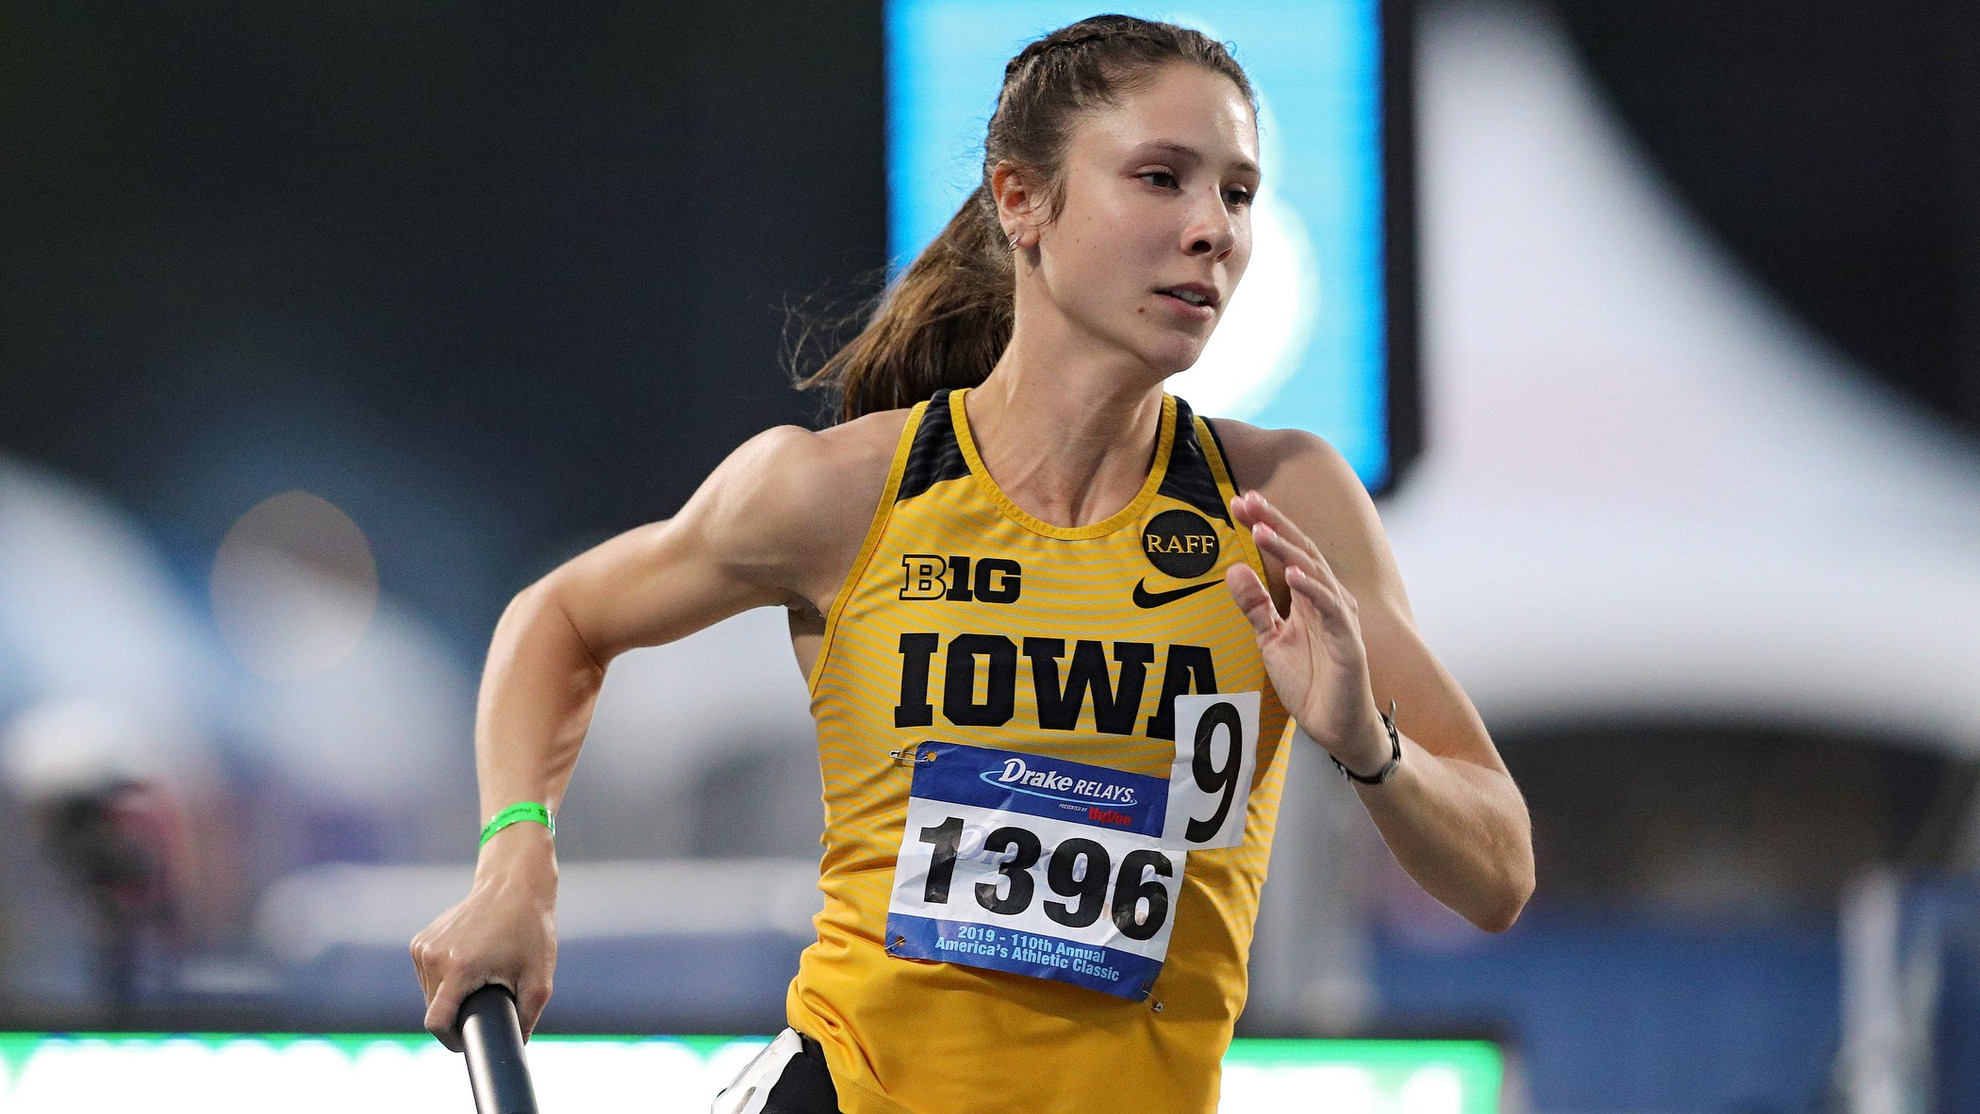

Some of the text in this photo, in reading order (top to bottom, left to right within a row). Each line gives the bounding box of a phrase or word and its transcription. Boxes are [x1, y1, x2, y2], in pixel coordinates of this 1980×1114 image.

[1145, 532, 1216, 556] RAFF
[894, 632, 1219, 742] IOWA
[998, 757, 1073, 791] Drake
[1184, 701, 1243, 844] 9
[918, 815, 1174, 941] 1396
[935, 936, 1120, 982] America's Athletic Classic
[957, 925, 996, 943] 2019
[1011, 933, 1053, 953] 110th
[1055, 942, 1106, 964] Annual
